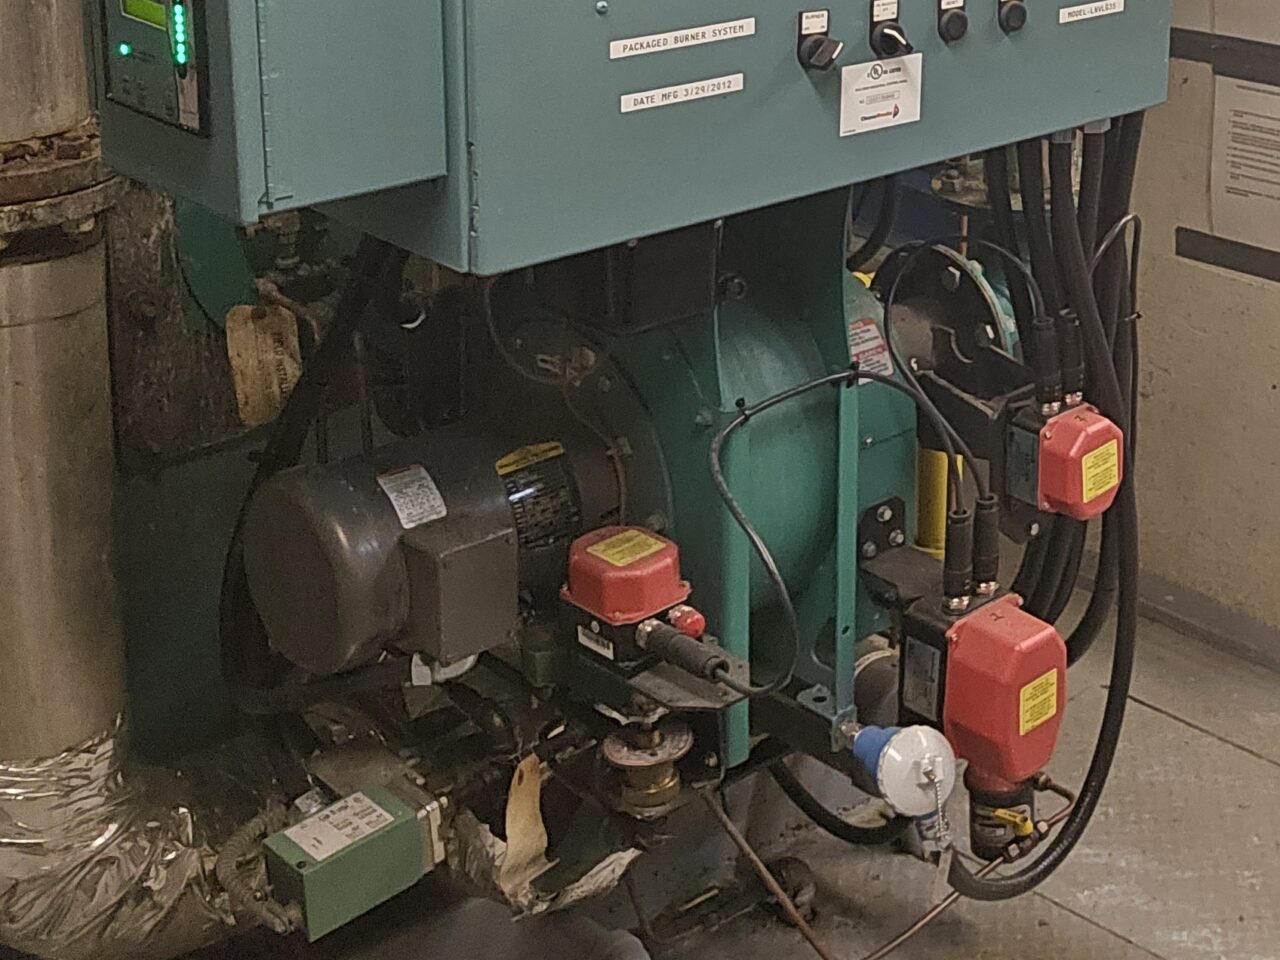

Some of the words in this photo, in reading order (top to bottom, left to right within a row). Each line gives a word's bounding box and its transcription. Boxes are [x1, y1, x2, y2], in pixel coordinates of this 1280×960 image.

[622, 38, 668, 53] PACKAGED
[674, 32, 706, 44] BURNER
[712, 24, 744, 37] SYSTEM
[633, 95, 655, 107] DATE
[662, 92, 678, 102] MFG
[684, 80, 732, 97] 3/29/2012
